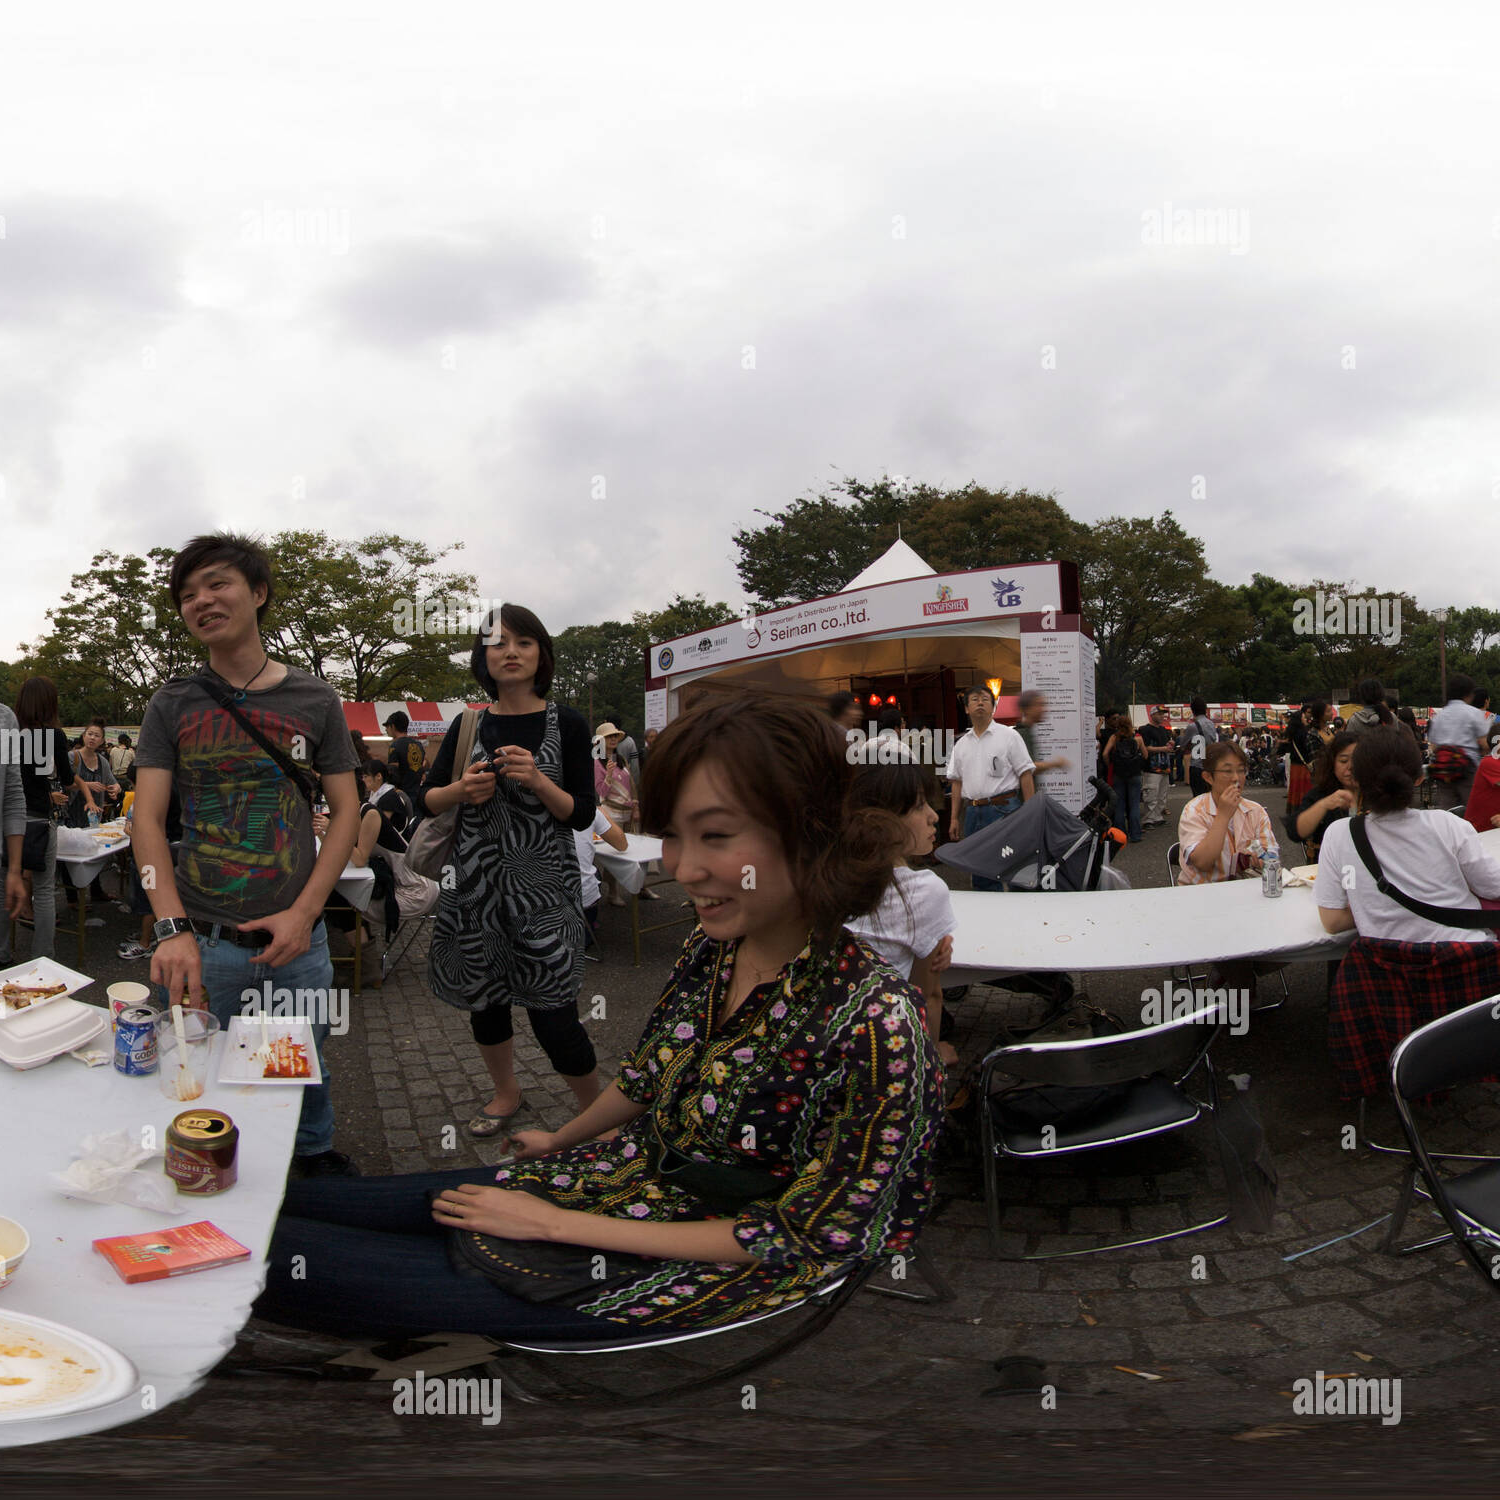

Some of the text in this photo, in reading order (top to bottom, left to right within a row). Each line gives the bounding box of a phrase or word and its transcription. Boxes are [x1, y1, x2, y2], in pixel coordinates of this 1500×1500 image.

[925, 600, 967, 615] KINGFISHER
[998, 594, 1022, 608] UB
[769, 614, 796, 627] Importer
[804, 605, 838, 618] Distributor
[846, 598, 868, 609] Japan
[770, 622, 817, 642] Seiman
